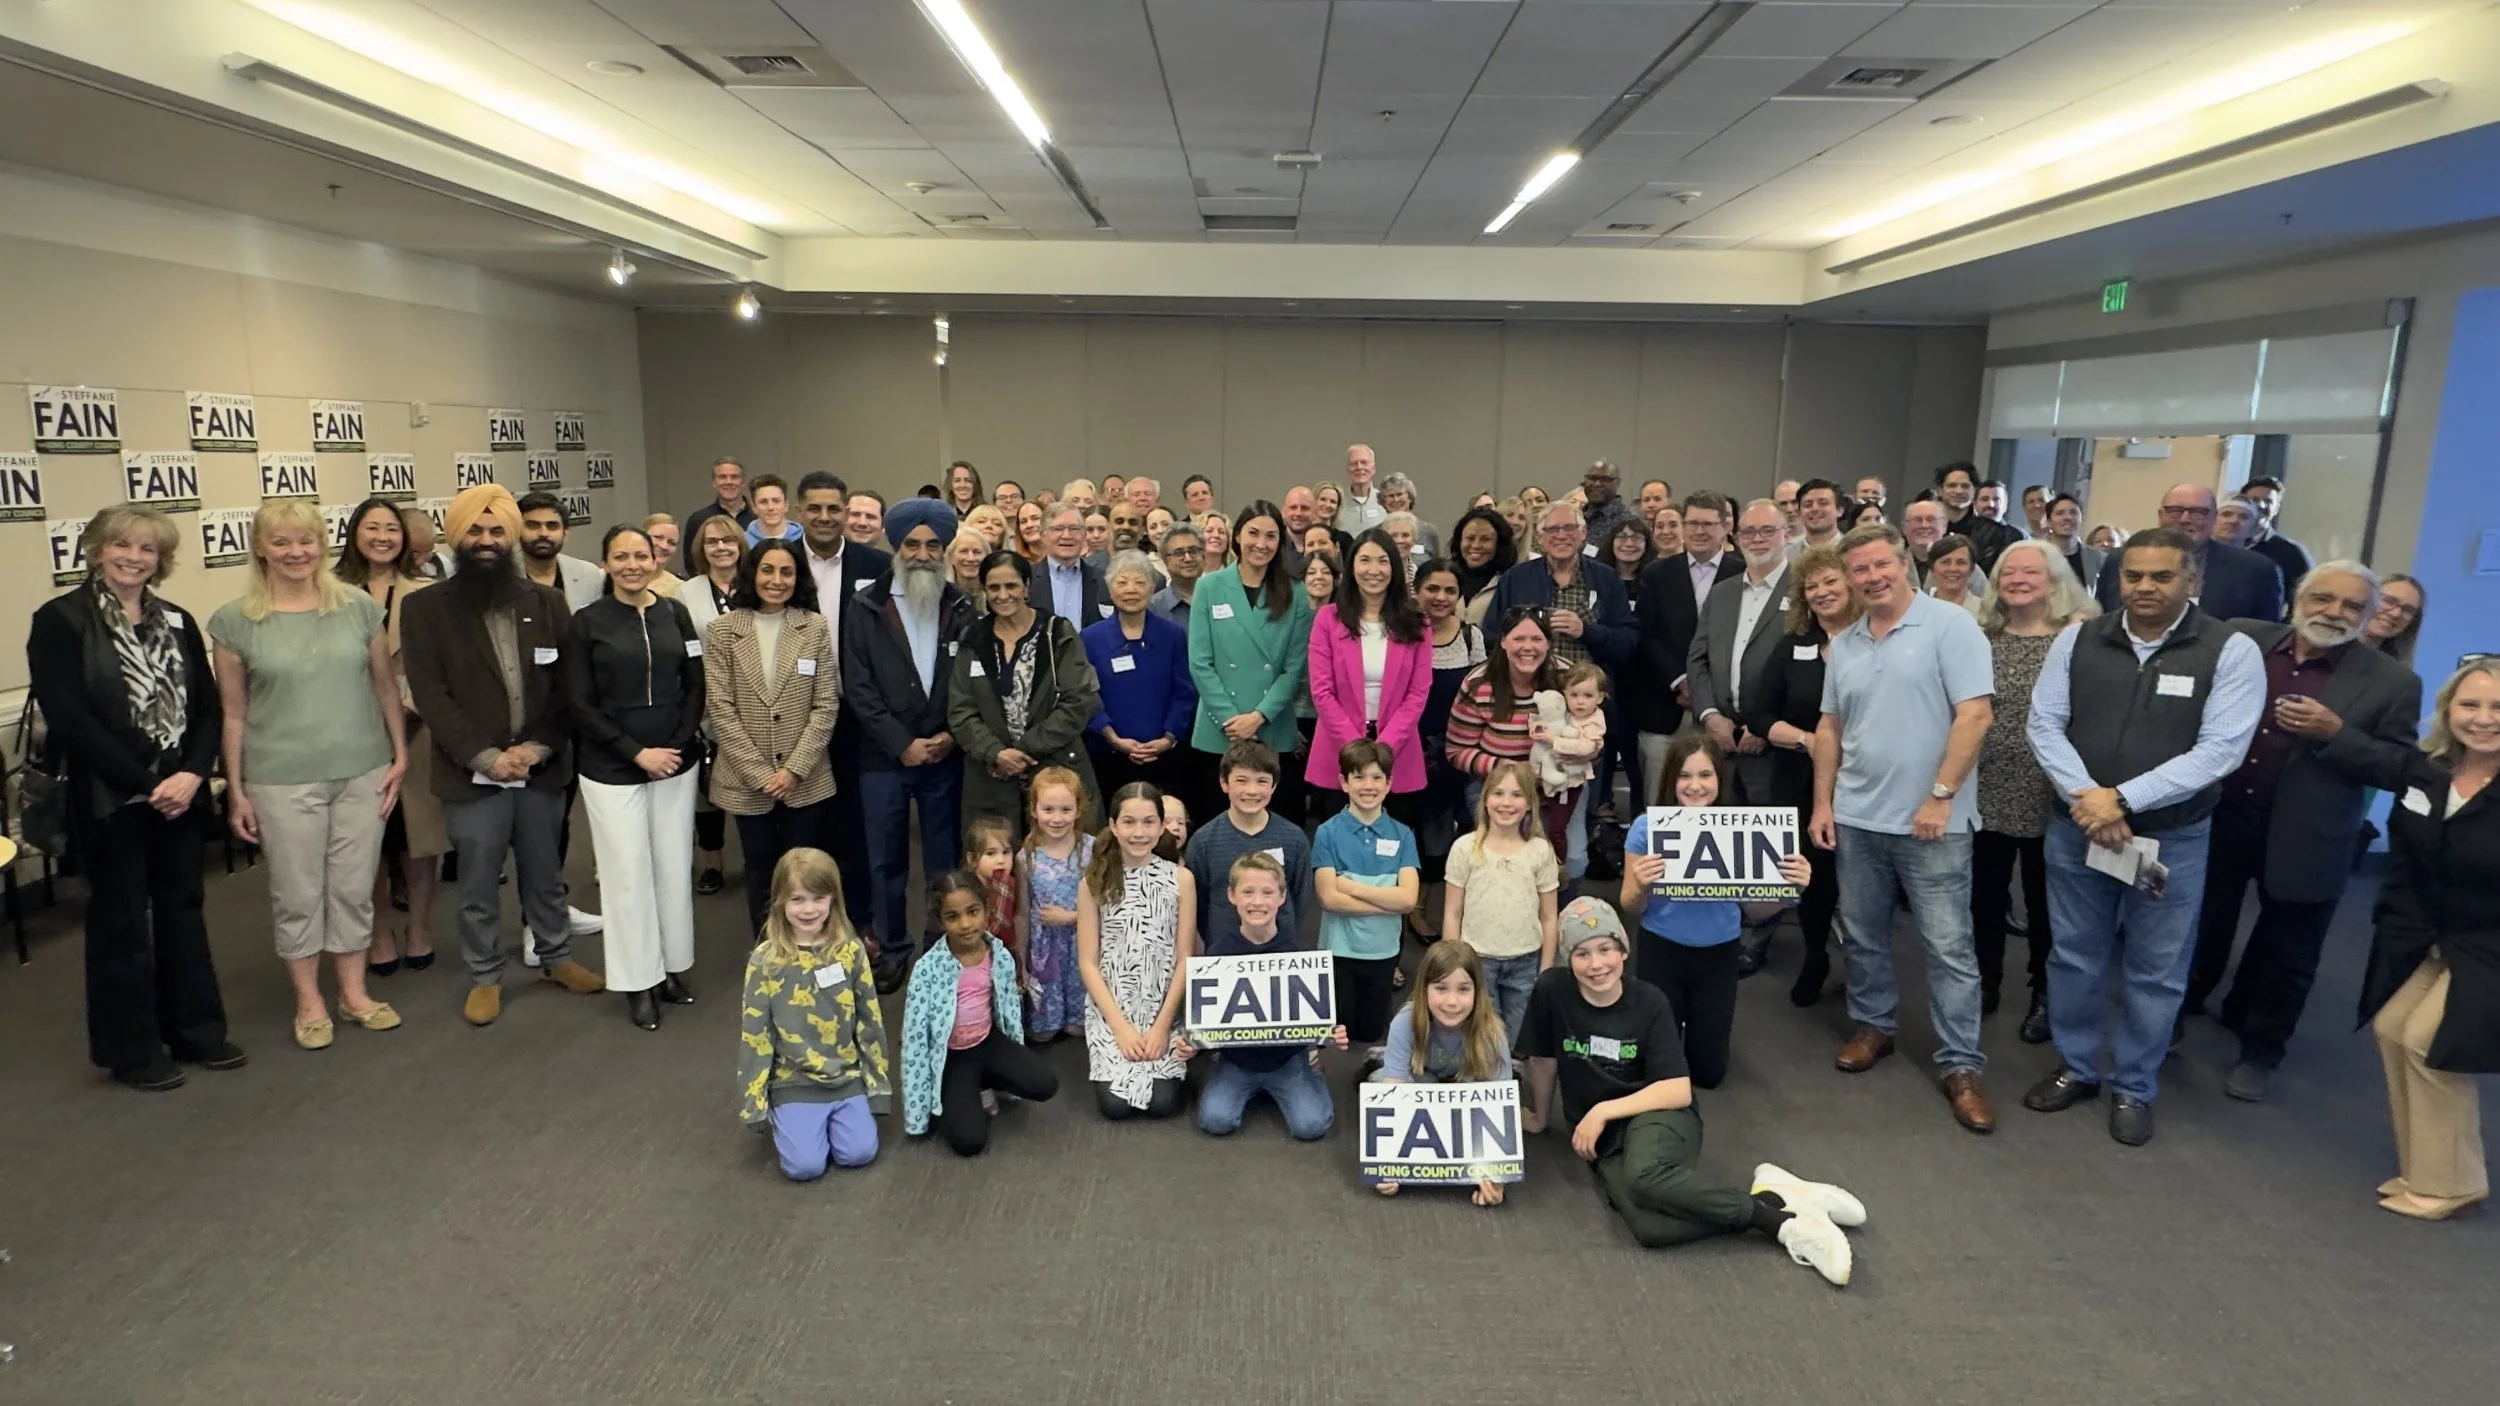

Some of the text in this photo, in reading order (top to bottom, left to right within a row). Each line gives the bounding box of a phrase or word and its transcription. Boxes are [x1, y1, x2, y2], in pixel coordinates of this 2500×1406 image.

[62, 390, 115, 401] STEFFANIE
[34, 401, 118, 437] FAIN
[190, 405, 255, 438] FAIN
[313, 412, 363, 440] FAIN
[490, 419, 525, 441] FAIN
[555, 421, 585, 441] FAIN
[150, 455, 195, 464] STEFFANIE
[587, 460, 613, 480] FAIN
[261, 465, 317, 494] FAIN
[369, 465, 415, 490] FAIN
[457, 463, 494, 486] FAIN
[528, 460, 559, 481] FAIN
[127, 466, 198, 499] FAIN
[1699, 813, 1794, 826] STEFFANIE
[1653, 831, 1794, 879] FAIN
[1666, 886, 1695, 896] KING
[1697, 886, 1744, 897] COUNTY
[1747, 886, 1799, 897] COUNCIL
[1237, 956, 1329, 973] STEFFANIE
[1191, 973, 1331, 1025] FAIN
[1203, 1030, 1232, 1041] KING
[1233, 1028, 1282, 1040] COUNTY
[1284, 1026, 1335, 1038] COUNCIL
[1415, 1088, 1514, 1103] STEFFANIE
[1365, 1105, 1517, 1159] FAIN
[1378, 1165, 1410, 1177] KING
[1412, 1165, 1464, 1178] COUNTY
[1467, 1163, 1523, 1176] COUNCIL
